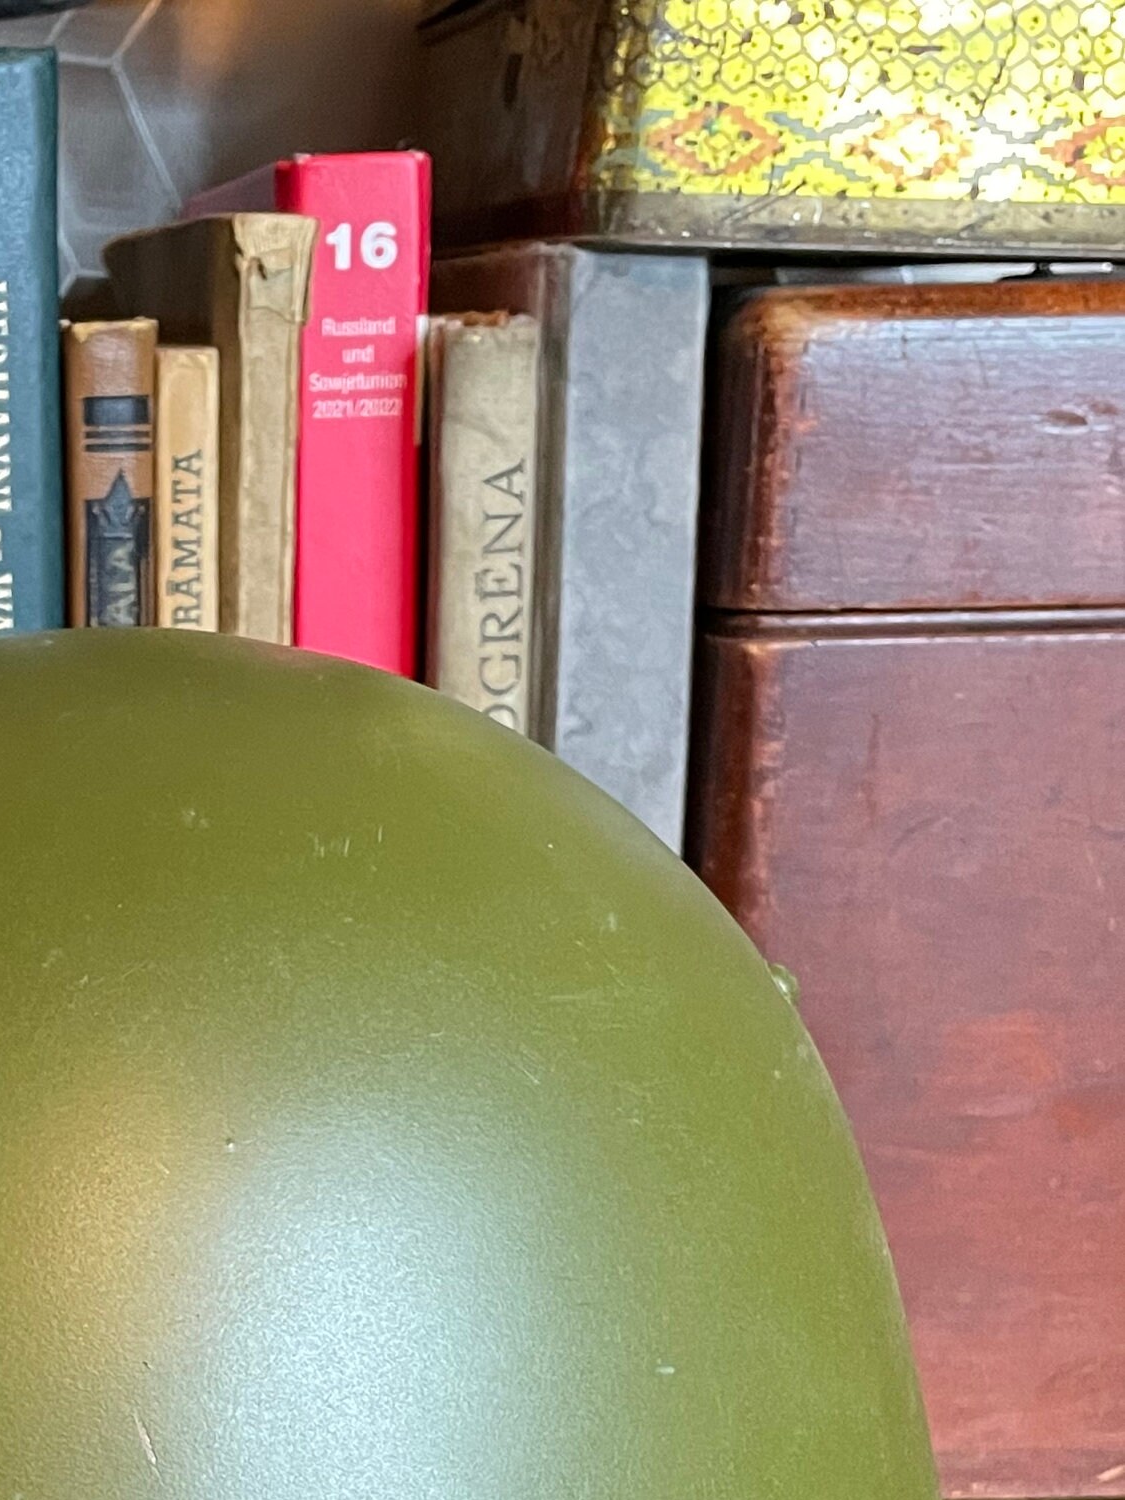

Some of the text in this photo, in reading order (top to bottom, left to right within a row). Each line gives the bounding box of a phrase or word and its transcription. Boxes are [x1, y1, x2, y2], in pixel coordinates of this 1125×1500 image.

[325, 221, 398, 271] 16
[321, 316, 397, 337] Russland
[342, 344, 375, 364] und
[309, 372, 408, 394] Sowjetunion
[312, 397, 403, 419] 2021/2022
